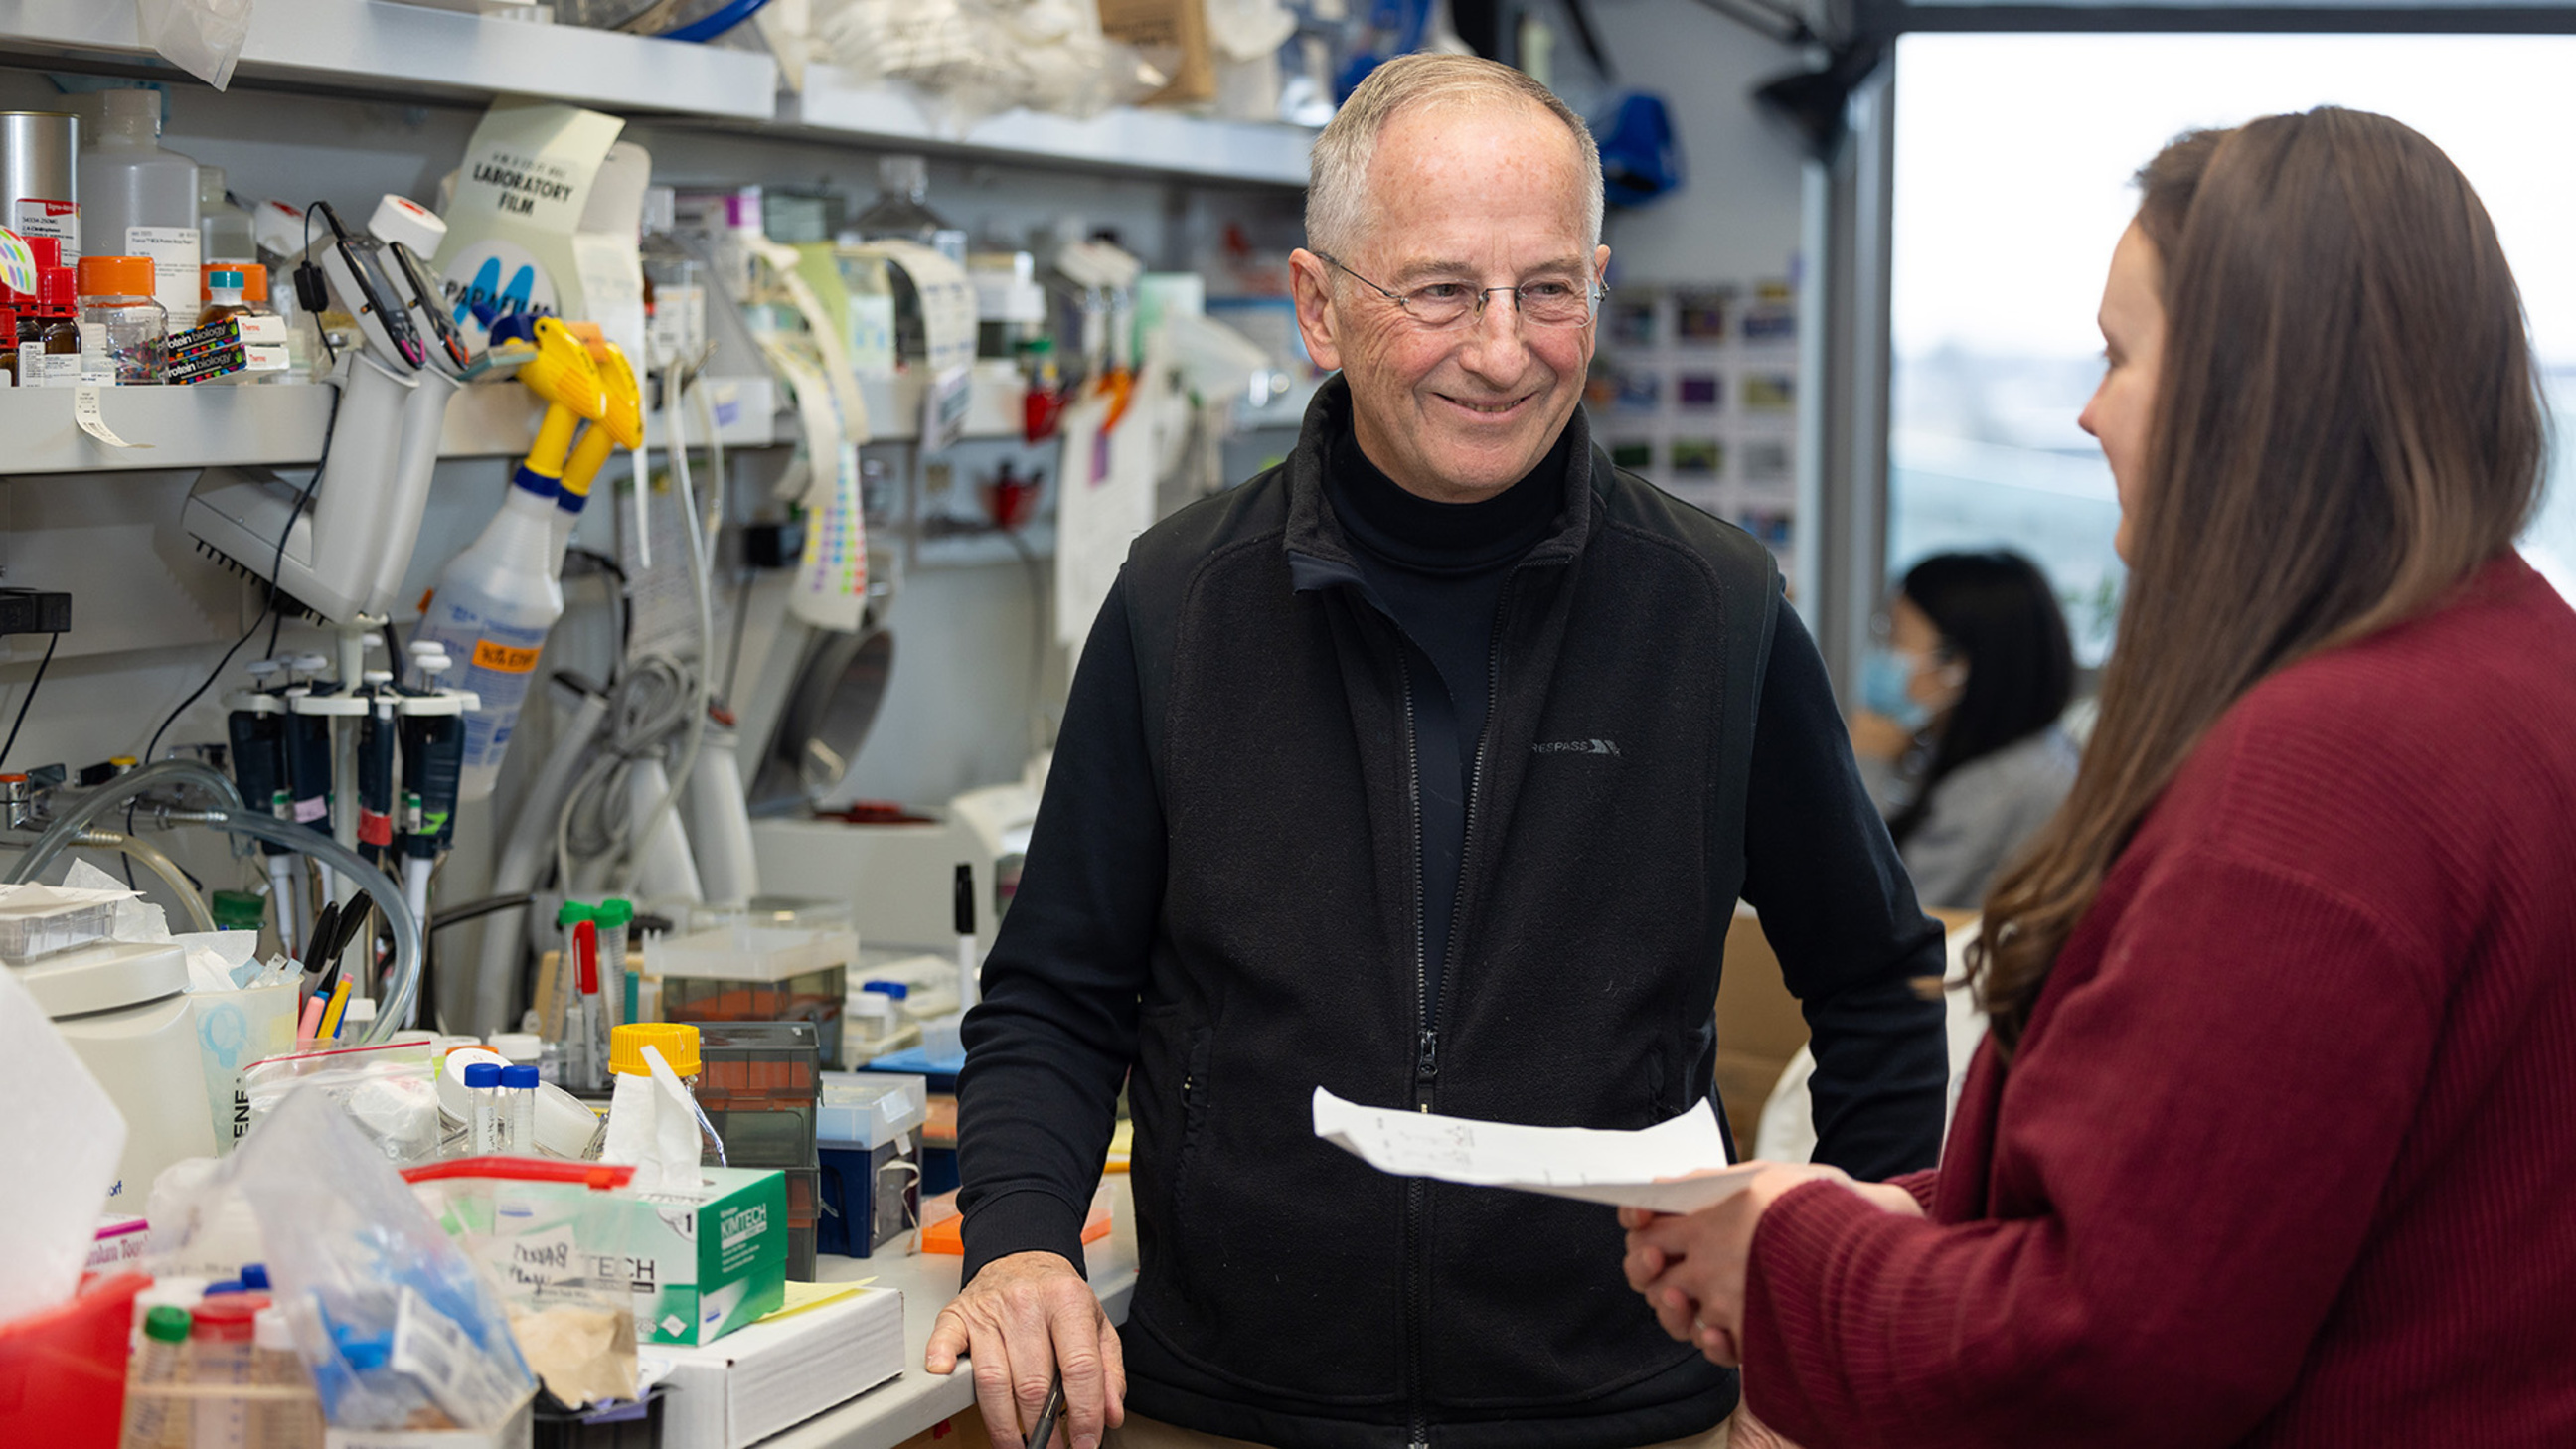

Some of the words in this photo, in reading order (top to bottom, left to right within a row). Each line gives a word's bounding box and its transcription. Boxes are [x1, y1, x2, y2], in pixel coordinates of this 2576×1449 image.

[472, 161, 574, 203] LABORATORY
[497, 191, 535, 217] FILM
[444, 281, 550, 315] PARAFIL
[191, 324, 227, 341] biology
[196, 353, 232, 369] biology
[1531, 740, 1588, 753] RESPASS
[685, 1213, 692, 1233] 1
[721, 1202, 767, 1239] KIMTECH
